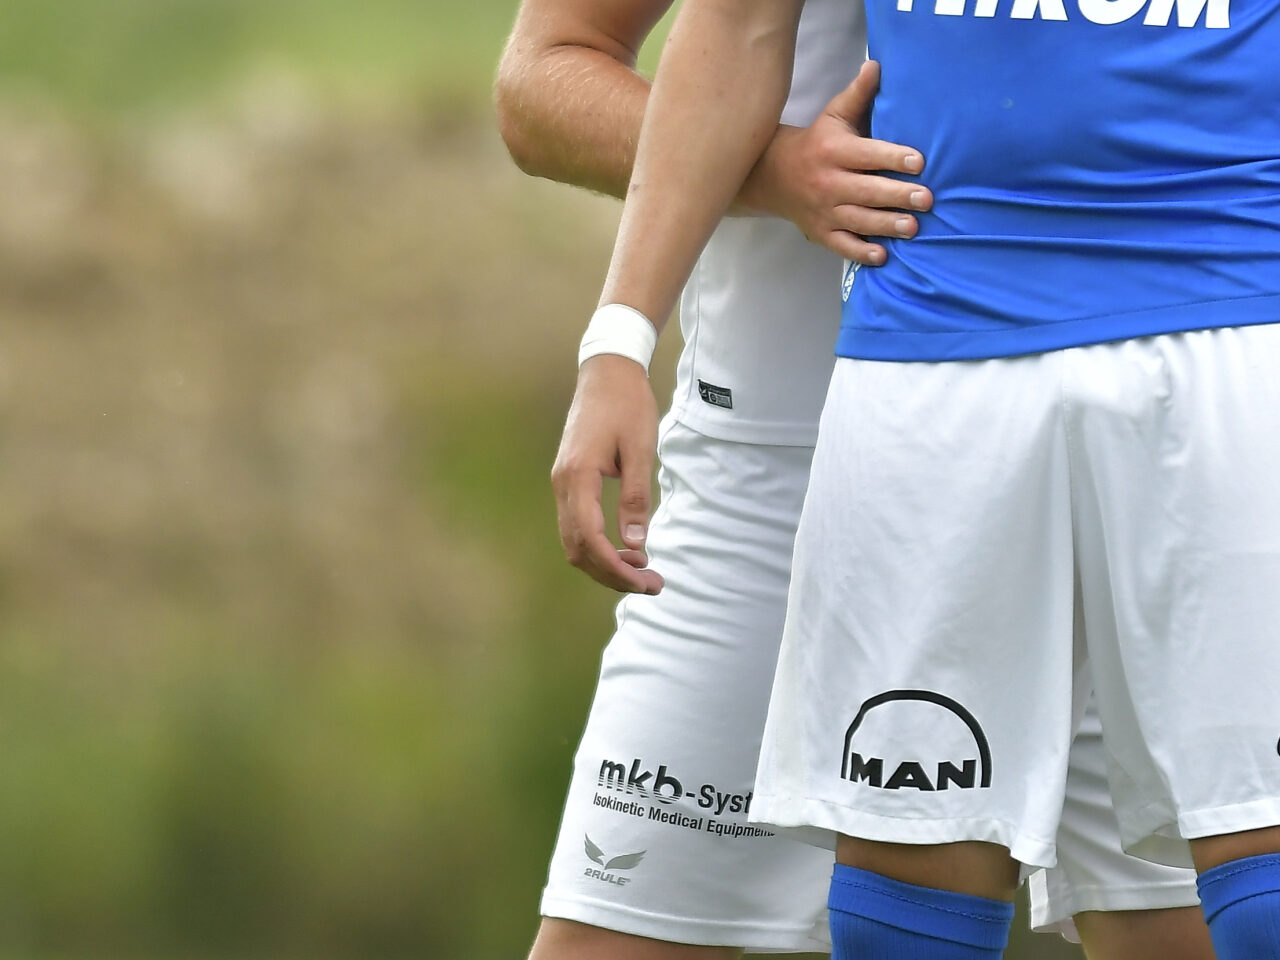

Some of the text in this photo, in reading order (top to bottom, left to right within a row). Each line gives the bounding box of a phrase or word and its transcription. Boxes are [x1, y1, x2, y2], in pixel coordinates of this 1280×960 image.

[850, 752, 977, 791] MAN
[593, 792, 644, 817] Isokinetic
[648, 807, 703, 830] Medical
